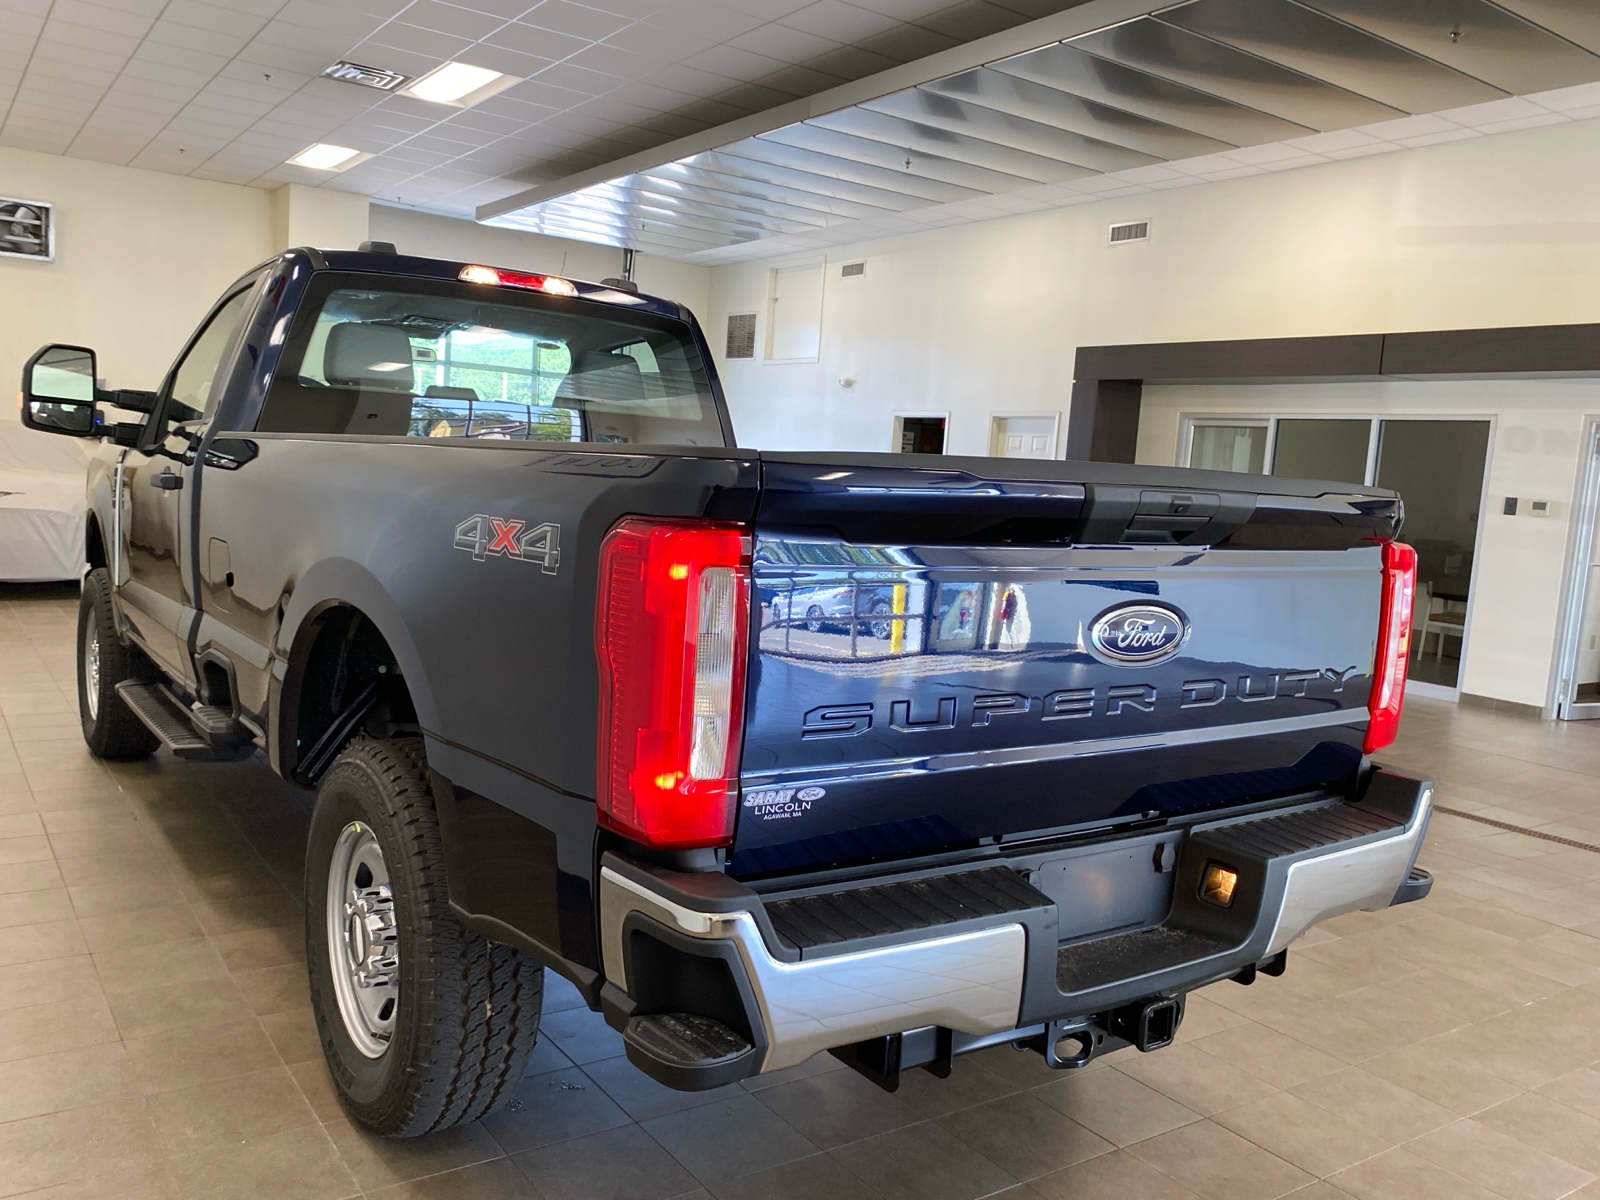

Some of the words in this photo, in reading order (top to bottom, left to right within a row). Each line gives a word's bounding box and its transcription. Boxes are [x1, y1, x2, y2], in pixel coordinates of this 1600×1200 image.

[1117, 618, 1167, 648] Ford
[801, 684, 1157, 740] SUPER
[1180, 665, 1358, 709] DUTY
[744, 789, 796, 806] SARAT
[755, 802, 811, 815] LINCOLN
[763, 812, 792, 820] AGAWAM,
